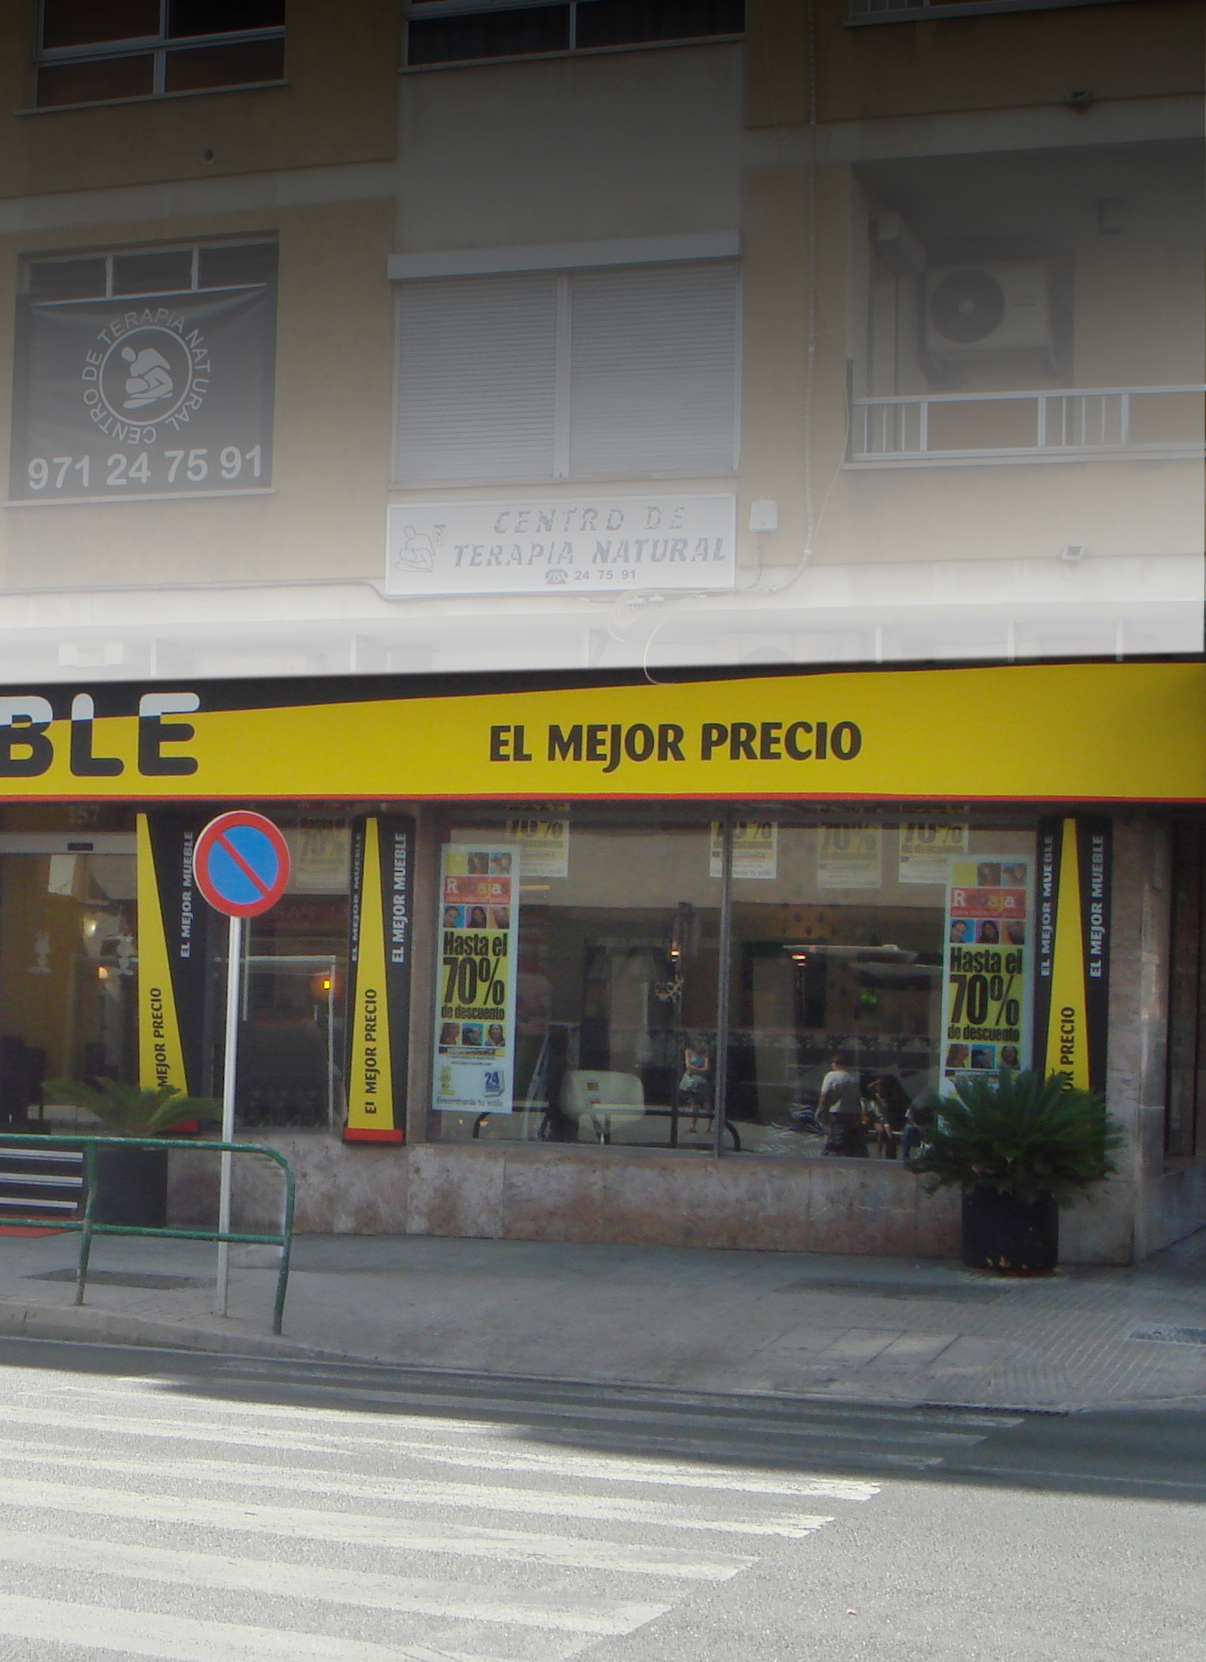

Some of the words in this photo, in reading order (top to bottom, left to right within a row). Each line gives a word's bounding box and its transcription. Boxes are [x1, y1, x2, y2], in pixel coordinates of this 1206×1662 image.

[97, 307, 185, 345] TERAPIA
[82, 350, 103, 381] DE
[165, 329, 210, 431] NATURAL
[83, 389, 157, 444] CENTRO
[28, 455, 90, 490] 971
[106, 452, 151, 486] 24
[164, 448, 208, 482] 75
[220, 444, 262, 479] 91
[493, 507, 625, 534] CENTRO
[643, 506, 686, 530] DE
[454, 541, 575, 567] TERAPIA
[591, 537, 726, 564] NATURAL
[574, 570, 590, 581] 24
[598, 569, 613, 580] 75
[621, 569, 636, 580] 91
[490, 725, 532, 761] EL
[548, 723, 685, 773] MEJOR
[700, 720, 863, 761] PRECIO
[183, 831, 194, 887] MUEBLE
[394, 832, 407, 891] MUEBLE
[1043, 835, 1053, 897] MUEBLE
[1092, 835, 1104, 898] MUEBLE
[181, 889, 194, 941] MEJOR
[392, 892, 409, 946] MEJOR
[1042, 901, 1053, 957] MEJOR
[1090, 901, 1106, 957] MEJOR
[180, 942, 190, 958] EL
[392, 948, 404, 964] EL
[443, 931, 488, 957] Hasta
[492, 932, 507, 957] el
[950, 946, 1001, 973] Hasta
[1005, 948, 1023, 974] el
[1041, 960, 1050, 976] EL
[443, 957, 505, 1005] 70%
[1090, 960, 1102, 978] EL
[150, 987, 165, 1039] PRECIO
[365, 988, 377, 1041] PRECIO
[441, 1006, 454, 1019] de
[454, 1005, 505, 1020] descuento
[949, 974, 1020, 1026] 70%
[948, 1025, 961, 1040] de
[963, 1024, 1020, 1042] descuento
[1060, 1006, 1075, 1065] PRECIO
[156, 1043, 171, 1089] MEJOR
[365, 1045, 380, 1094] MEJOR
